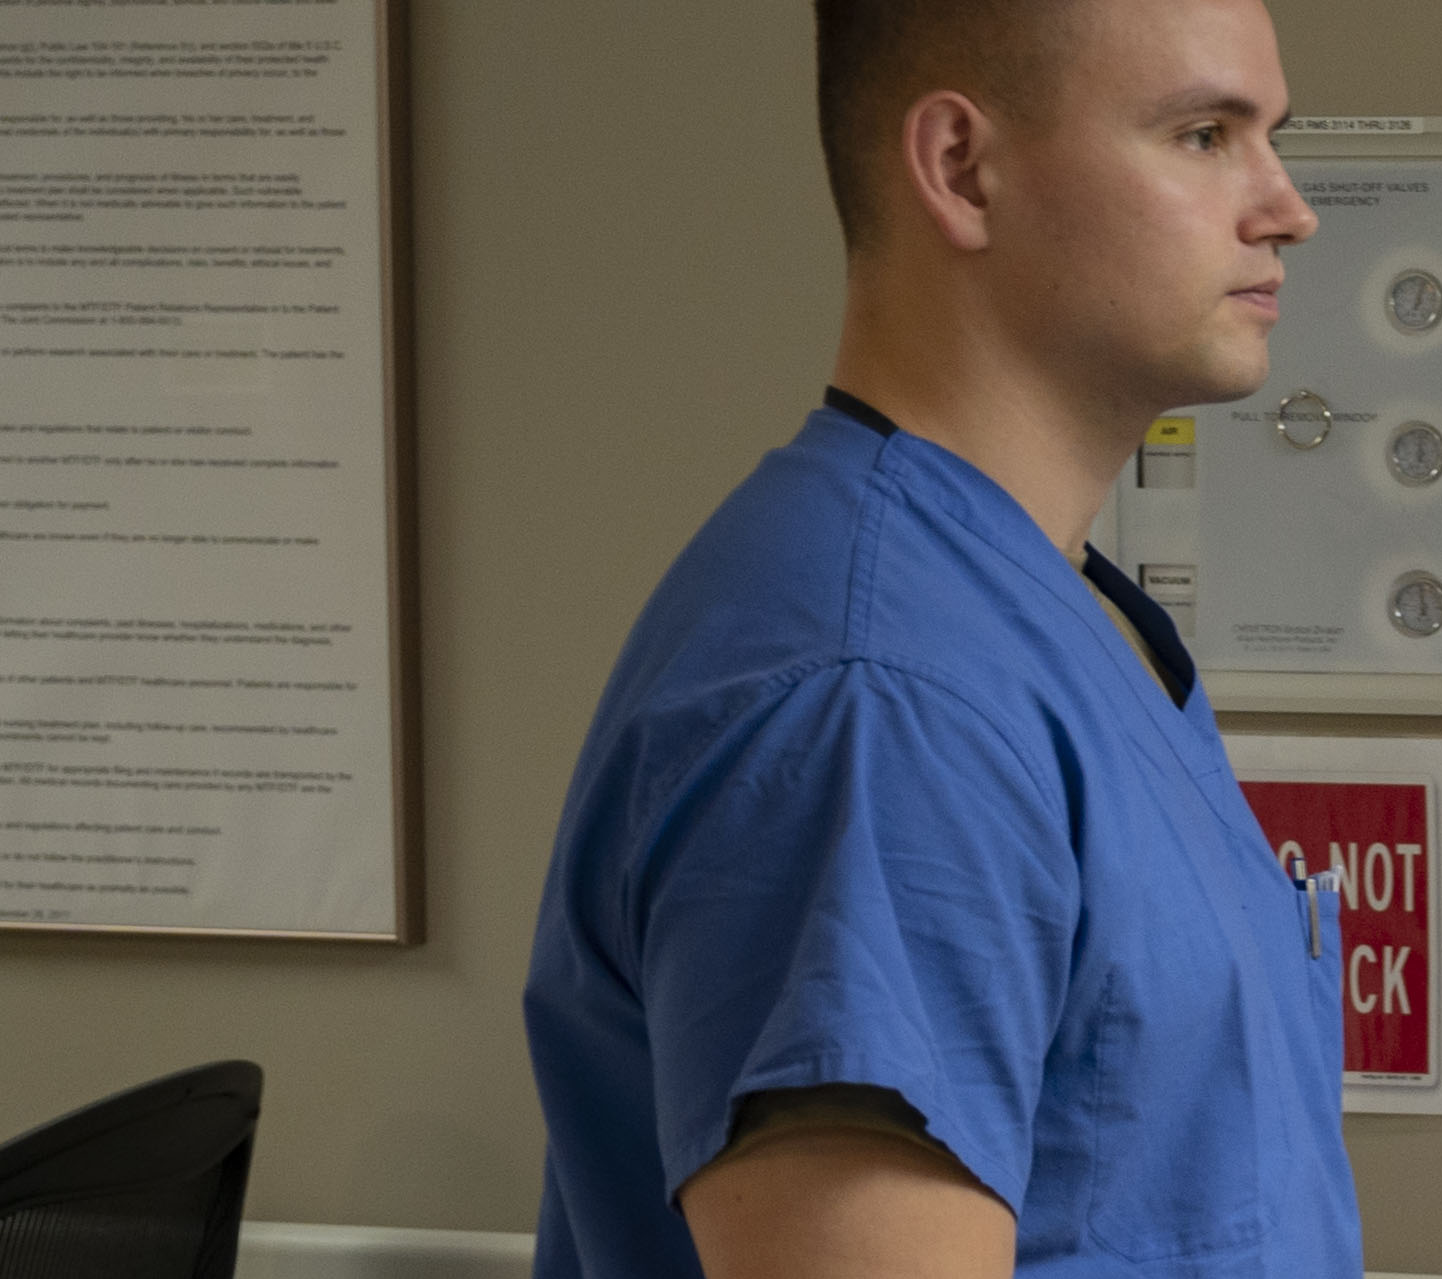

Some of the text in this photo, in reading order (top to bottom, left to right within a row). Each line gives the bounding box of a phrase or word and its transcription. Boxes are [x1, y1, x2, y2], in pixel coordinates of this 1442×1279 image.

[1387, 182, 1431, 194] VALVES
[1311, 196, 1380, 208] EMERGENCY
[1149, 575, 1192, 586] VACUUM
[1329, 842, 1422, 912] NOT
[1349, 944, 1412, 1015] CK
